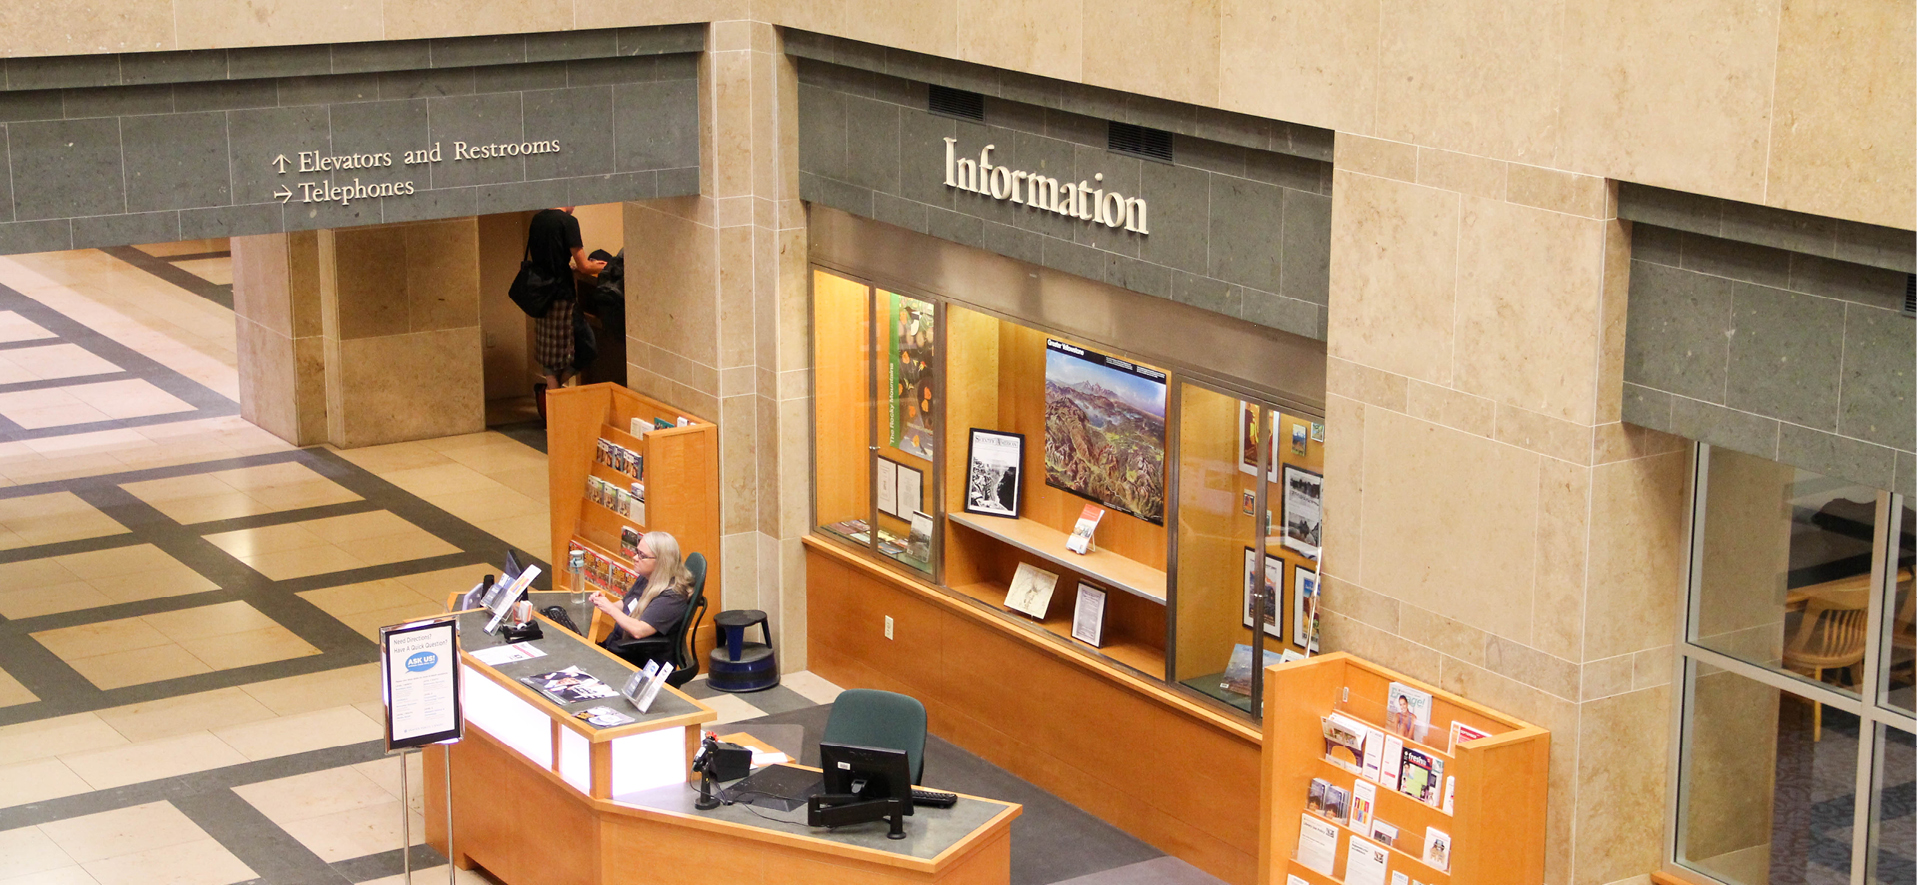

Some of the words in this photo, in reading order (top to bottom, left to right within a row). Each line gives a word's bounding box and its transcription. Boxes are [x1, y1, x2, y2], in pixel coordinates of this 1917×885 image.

[298, 150, 392, 173] Elevators
[404, 142, 442, 165] and
[454, 138, 561, 161] Restrooms
[298, 178, 415, 206] Telephones
[943, 136, 1149, 235] Information
[407, 633, 432, 643] Directions?
[425, 639, 448, 648] Question?
[407, 657, 423, 665] ASK
[423, 655, 436, 663] US!
[1390, 686, 1426, 708] Enage!
